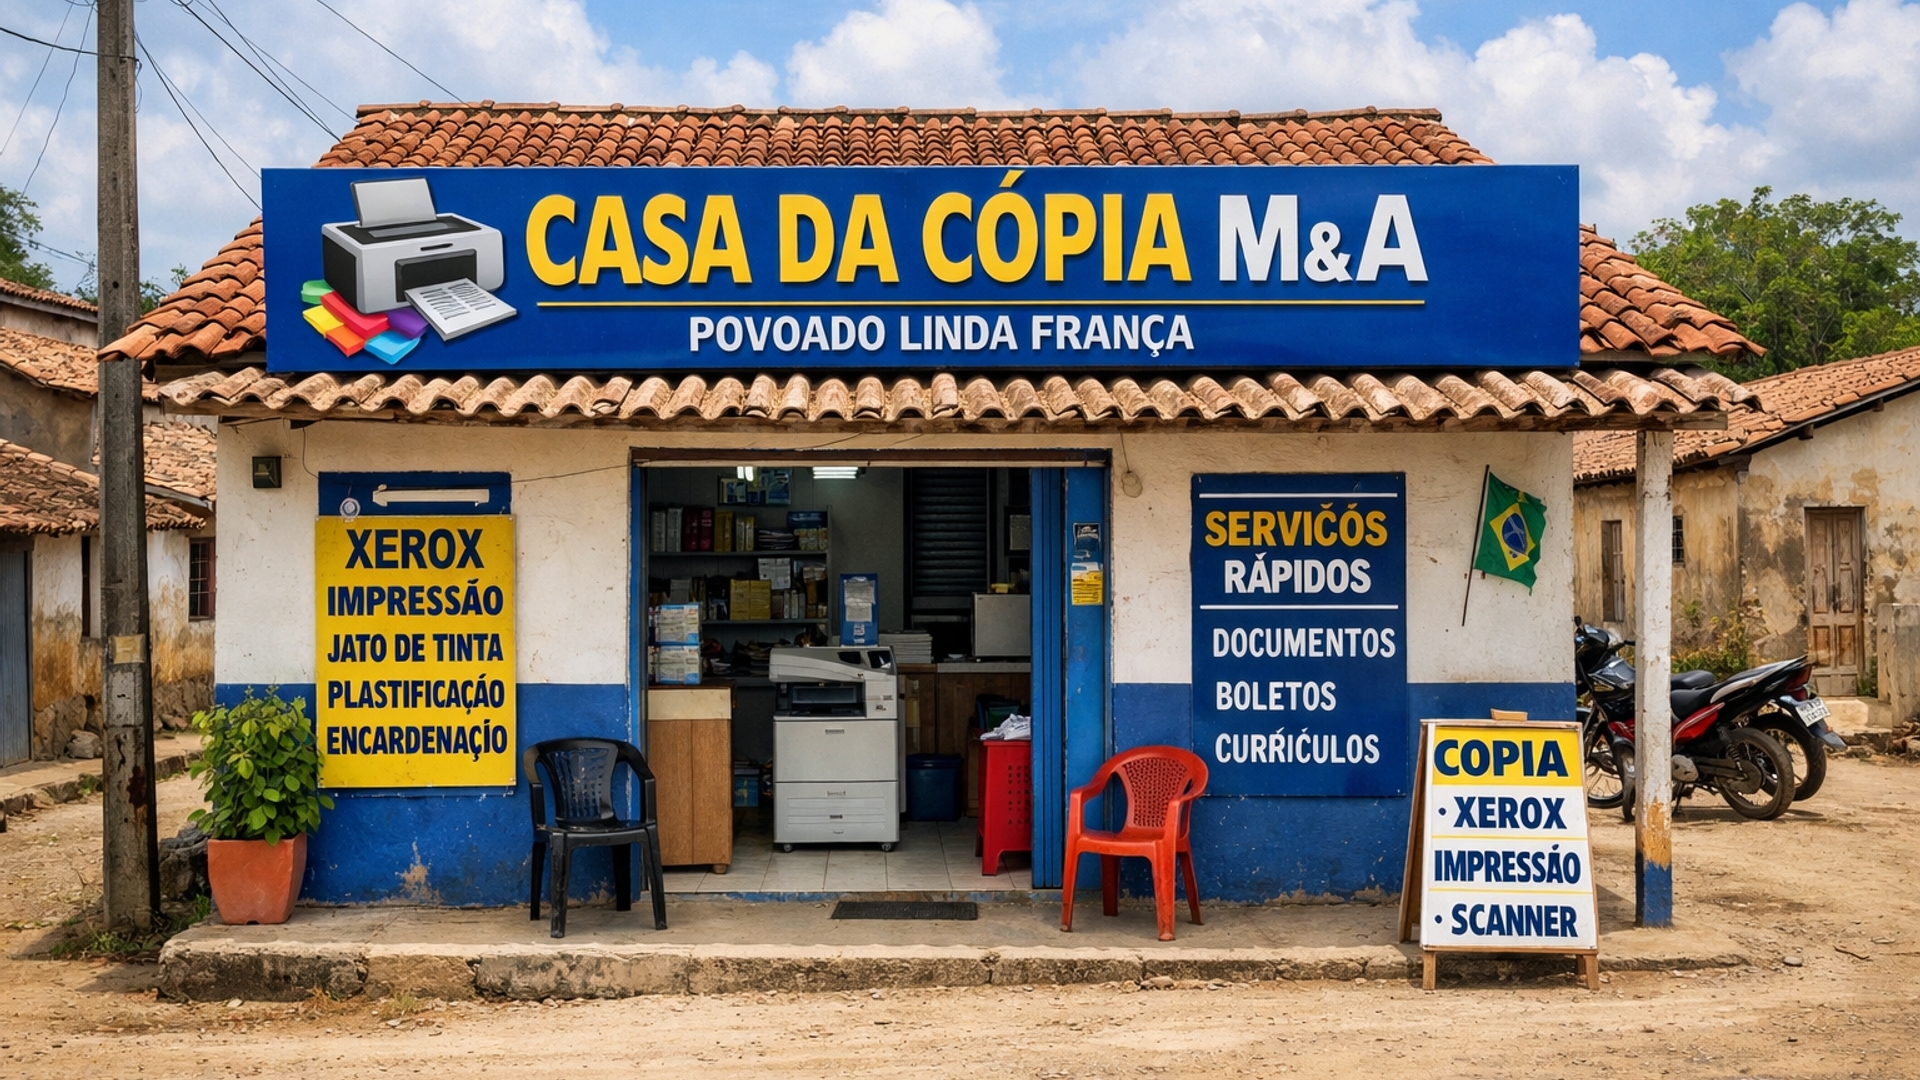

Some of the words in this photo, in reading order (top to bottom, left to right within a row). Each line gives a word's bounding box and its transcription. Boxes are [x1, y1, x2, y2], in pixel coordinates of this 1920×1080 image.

[525, 192, 753, 286] CASA
[778, 193, 900, 283] DA
[922, 169, 1192, 283] CÓPIA
[1219, 194, 1429, 283] M&A
[689, 315, 886, 352] POVOADO
[900, 315, 1018, 351] LINDA
[1031, 314, 1195, 358] FRANÇA
[345, 528, 485, 570] XEROX
[327, 633, 387, 663] JATO
[394, 633, 426, 663] DE
[432, 633, 504, 662] TINTA
[1213, 627, 1396, 658] DOCUMENTOS
[1216, 680, 1337, 712] BOLETOS
[1433, 739, 1569, 777] COPIA
[1453, 796, 1567, 830] XEROX
[1451, 903, 1579, 938] SCANNER
